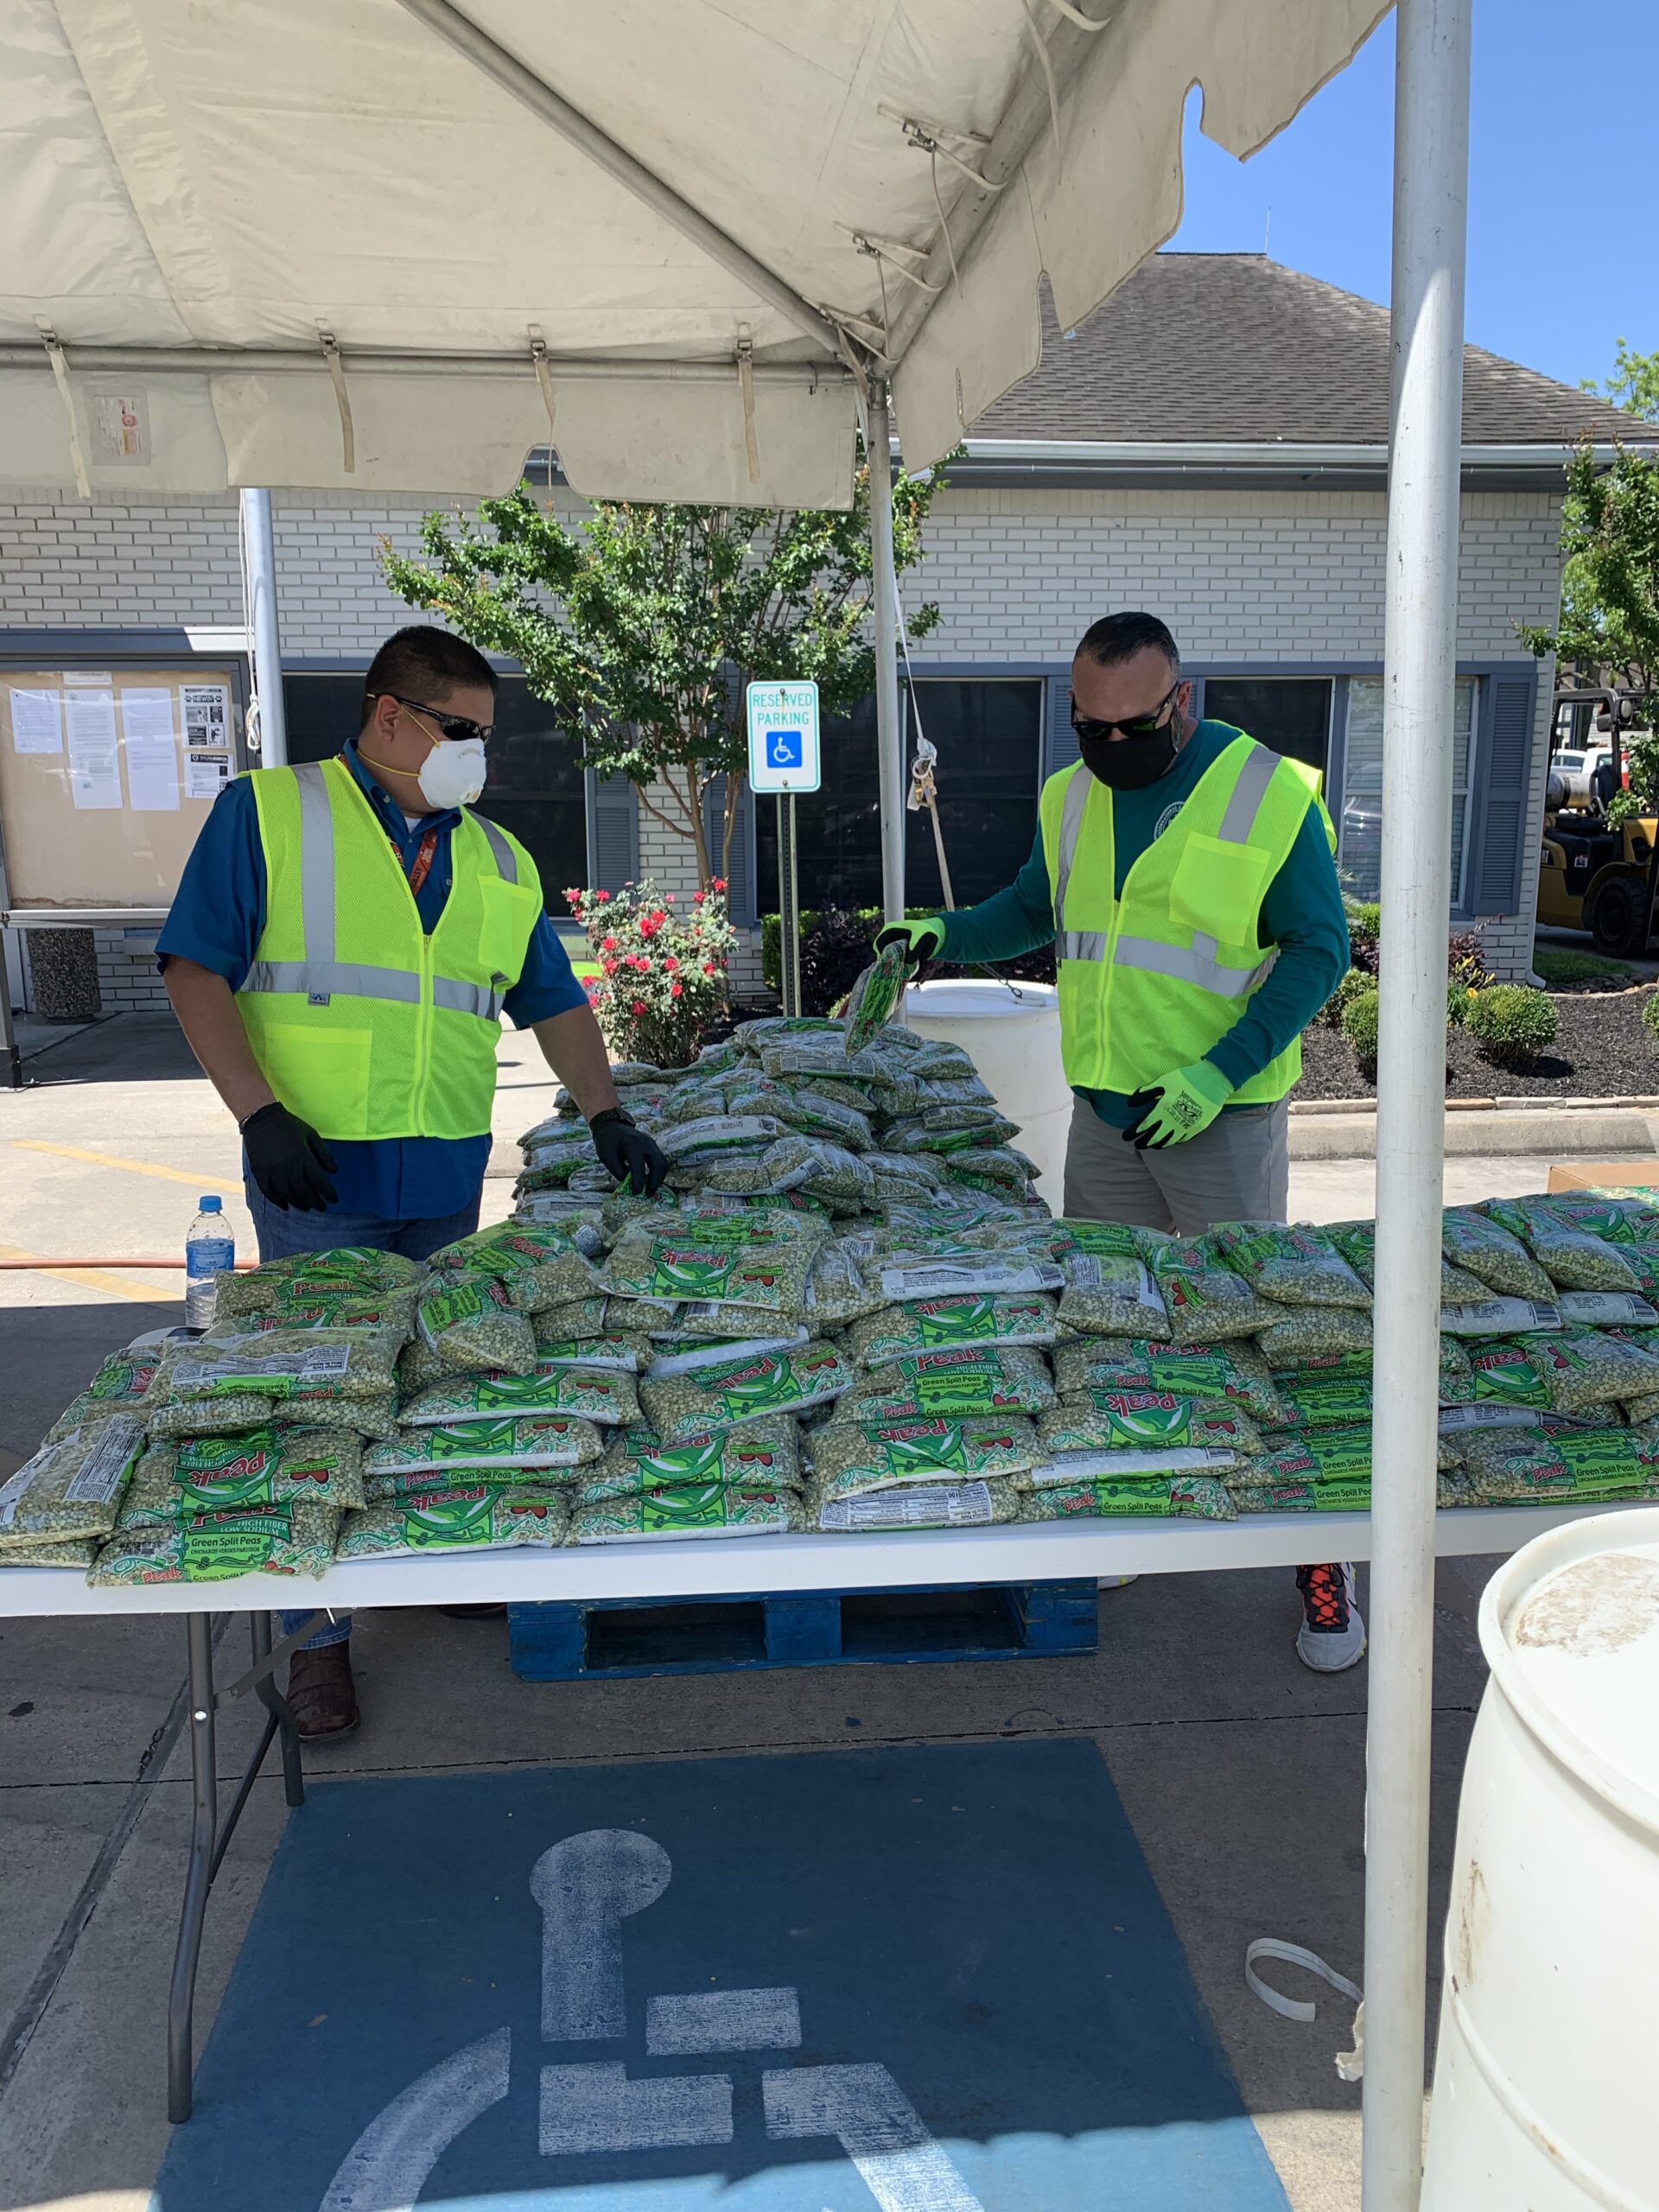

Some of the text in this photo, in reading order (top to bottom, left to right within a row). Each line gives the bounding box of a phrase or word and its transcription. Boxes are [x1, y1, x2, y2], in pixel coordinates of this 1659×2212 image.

[753, 693, 812, 708] RESERVED
[757, 712, 810, 726] PARKING
[661, 1248, 727, 1268] Peak
[293, 1279, 361, 1296] Peak
[915, 1294, 982, 1316] Peak
[916, 1347, 985, 1372] Peak
[1306, 1354, 1340, 1369] Peak
[1473, 1350, 1529, 1371] eak
[714, 1356, 776, 1390] Peak
[1116, 1373, 1151, 1388] Peak
[1159, 1383, 1217, 1398] Green Split Peas
[882, 1398, 919, 1420] Peak
[926, 1408, 949, 1416] Green
[950, 1407, 965, 1415] Split
[1104, 1392, 1178, 1419] Peak
[877, 1418, 949, 1442] Peak
[188, 1452, 267, 1487] Peak
[1278, 1455, 1313, 1477] Peak
[1323, 1460, 1347, 1469] Green
[1347, 1458, 1363, 1468] Split
[1532, 1461, 1567, 1483] Peak
[1576, 1468, 1599, 1477] Green
[1599, 1465, 1615, 1474] Split
[404, 1469, 442, 1491] Peak
[451, 1471, 512, 1481] Green Split Peas
[408, 1485, 486, 1512] Peak
[1270, 1484, 1307, 1503] Peak
[1317, 1487, 1372, 1498] Green Split Pea
[1063, 1491, 1096, 1515] Peak
[1103, 1502, 1162, 1510] Green Split Peas
[243, 1526, 279, 1535] SODIUM
[264, 1520, 288, 1531] FIBER
[191, 1535, 262, 1548] Green Split Peas
[142, 1566, 183, 1585] Peak
